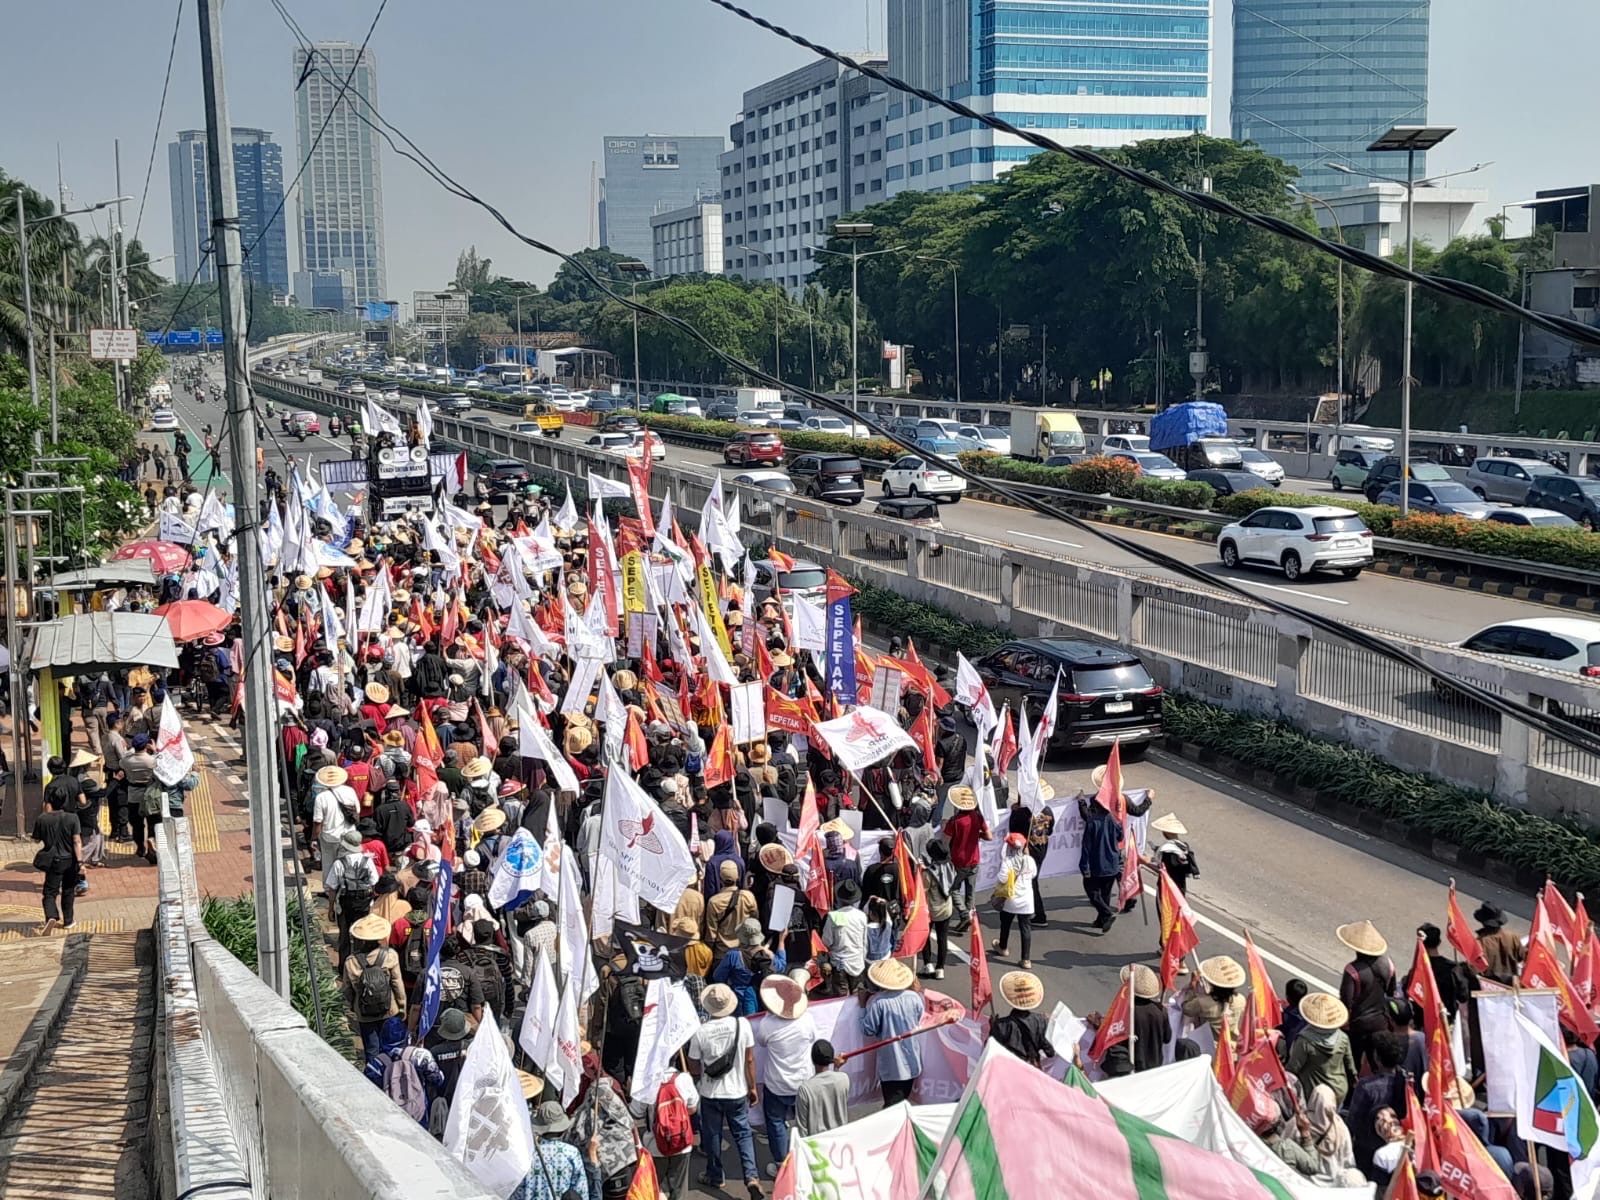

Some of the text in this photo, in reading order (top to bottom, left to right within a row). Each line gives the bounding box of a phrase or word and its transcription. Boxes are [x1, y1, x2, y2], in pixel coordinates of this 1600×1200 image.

[608, 140, 637, 149] DIPO
[831, 604, 845, 691] SEPETAK
[769, 713, 800, 729] SEPETAK
